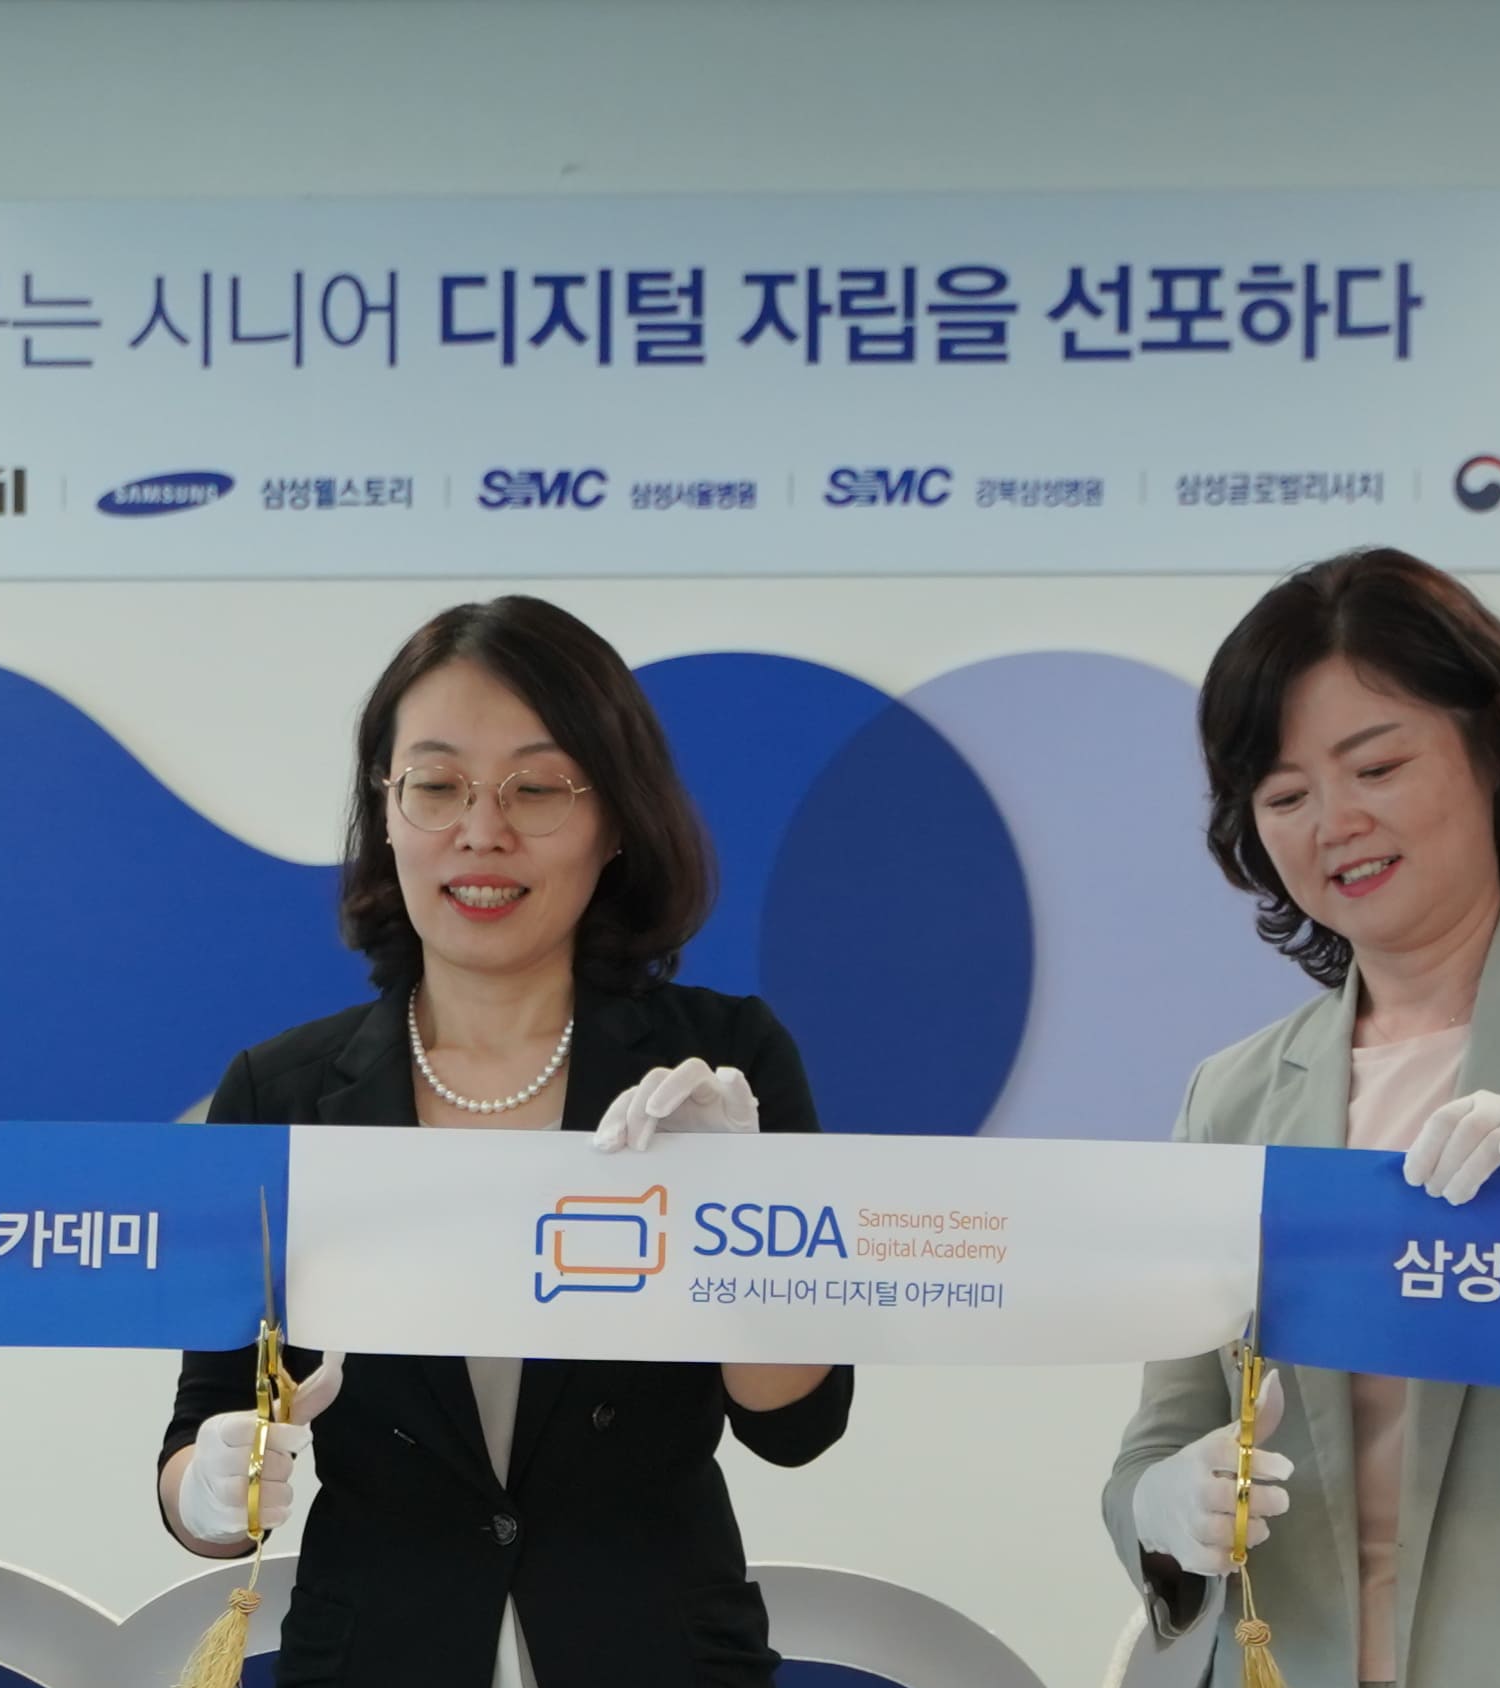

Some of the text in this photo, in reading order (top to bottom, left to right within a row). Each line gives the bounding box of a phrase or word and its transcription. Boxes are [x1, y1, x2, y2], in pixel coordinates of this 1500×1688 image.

[128, 271, 400, 370] 시니어
[437, 267, 708, 367] 디지털
[738, 265, 1020, 366] 자립을
[1045, 262, 1424, 362] 선포하다
[261, 476, 414, 511] 삼성웰스토리
[693, 1202, 848, 1259] SSDA
[858, 1208, 1008, 1234] Samsung Senior
[857, 1236, 1007, 1264] Digital Academy
[689, 1276, 1004, 1309] 삼성 시니어 디지털 아카데미
